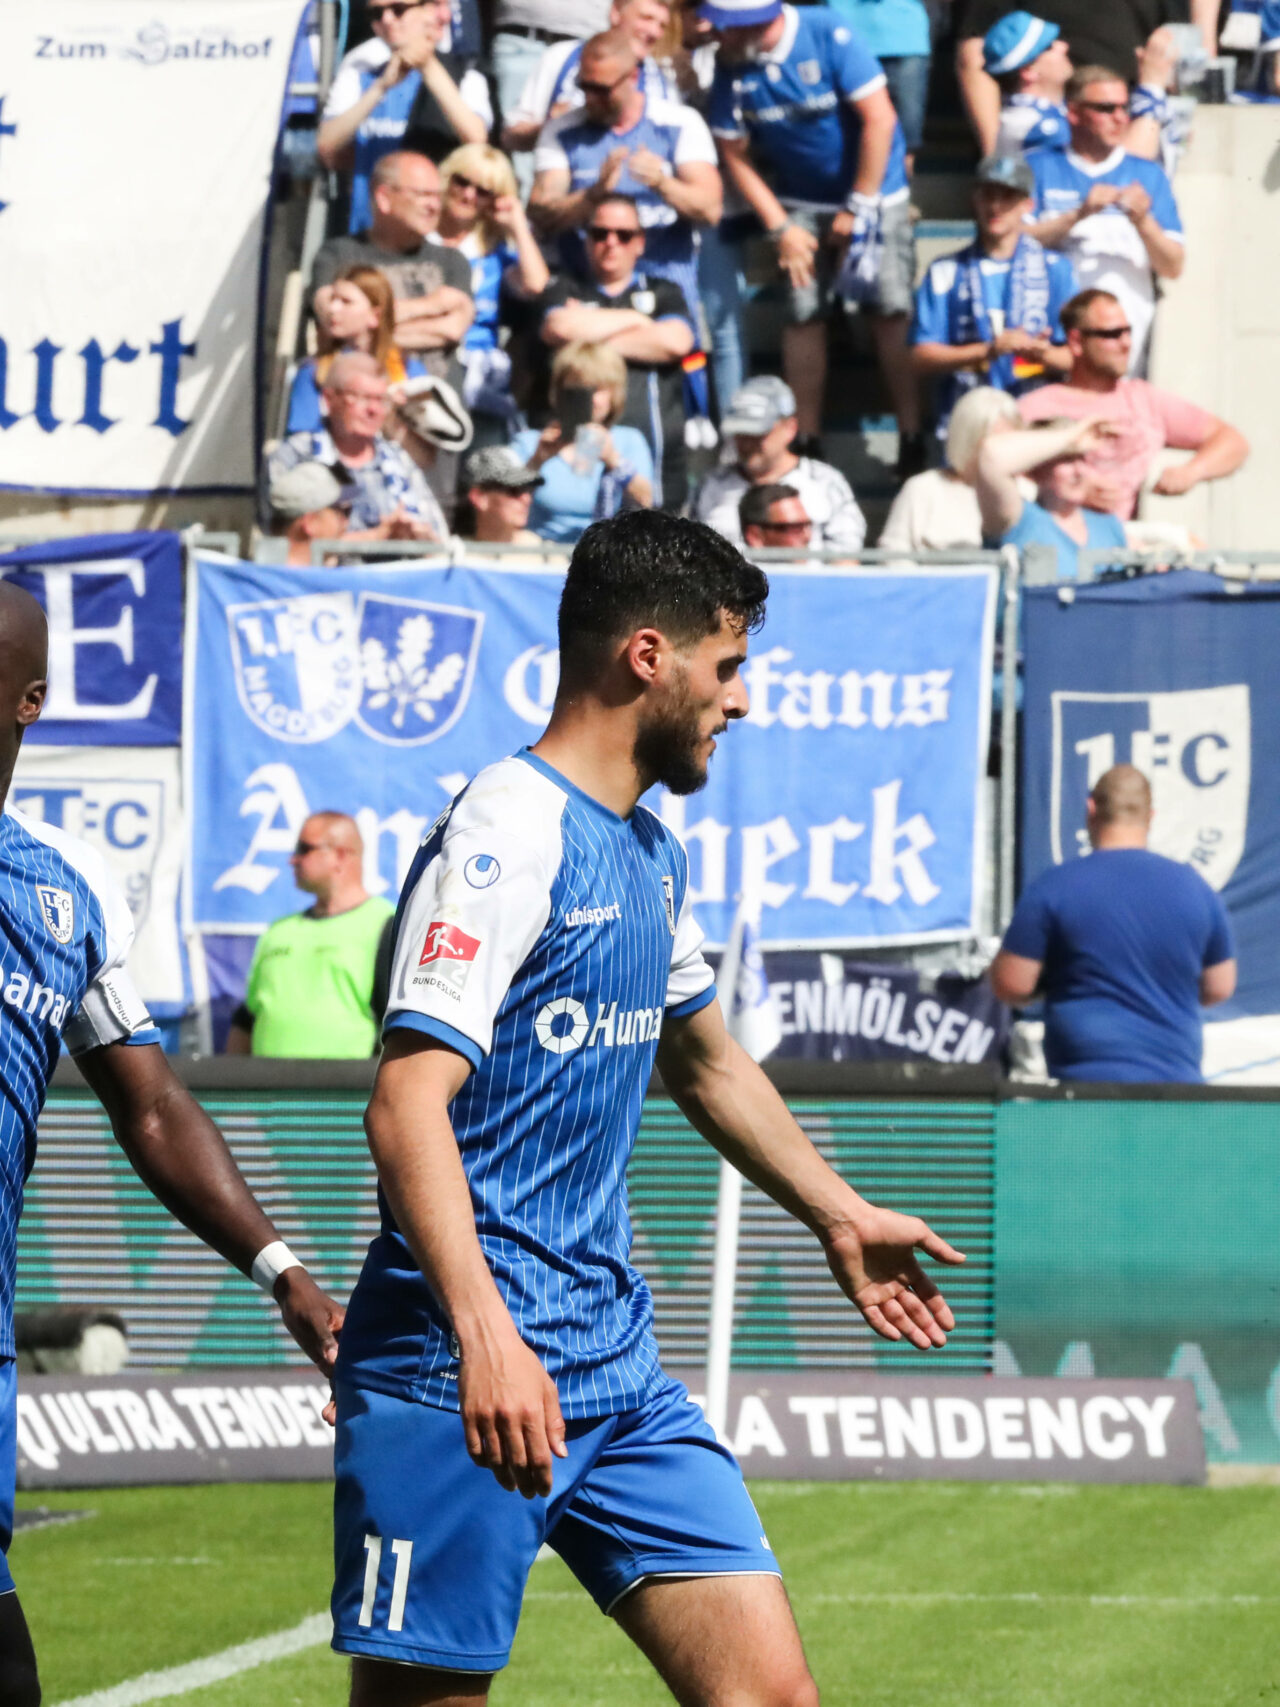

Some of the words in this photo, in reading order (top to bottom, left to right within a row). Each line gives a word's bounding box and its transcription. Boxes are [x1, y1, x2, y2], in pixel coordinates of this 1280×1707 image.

[35, 36, 107, 58] Zum
[565, 901, 622, 927] uhlsport
[412, 976, 462, 1003] BUNDESLIGA
[40, 1388, 197, 1454] ULTRA
[789, 1395, 1176, 1460] TENDENCY
[358, 1533, 414, 1632] 11
